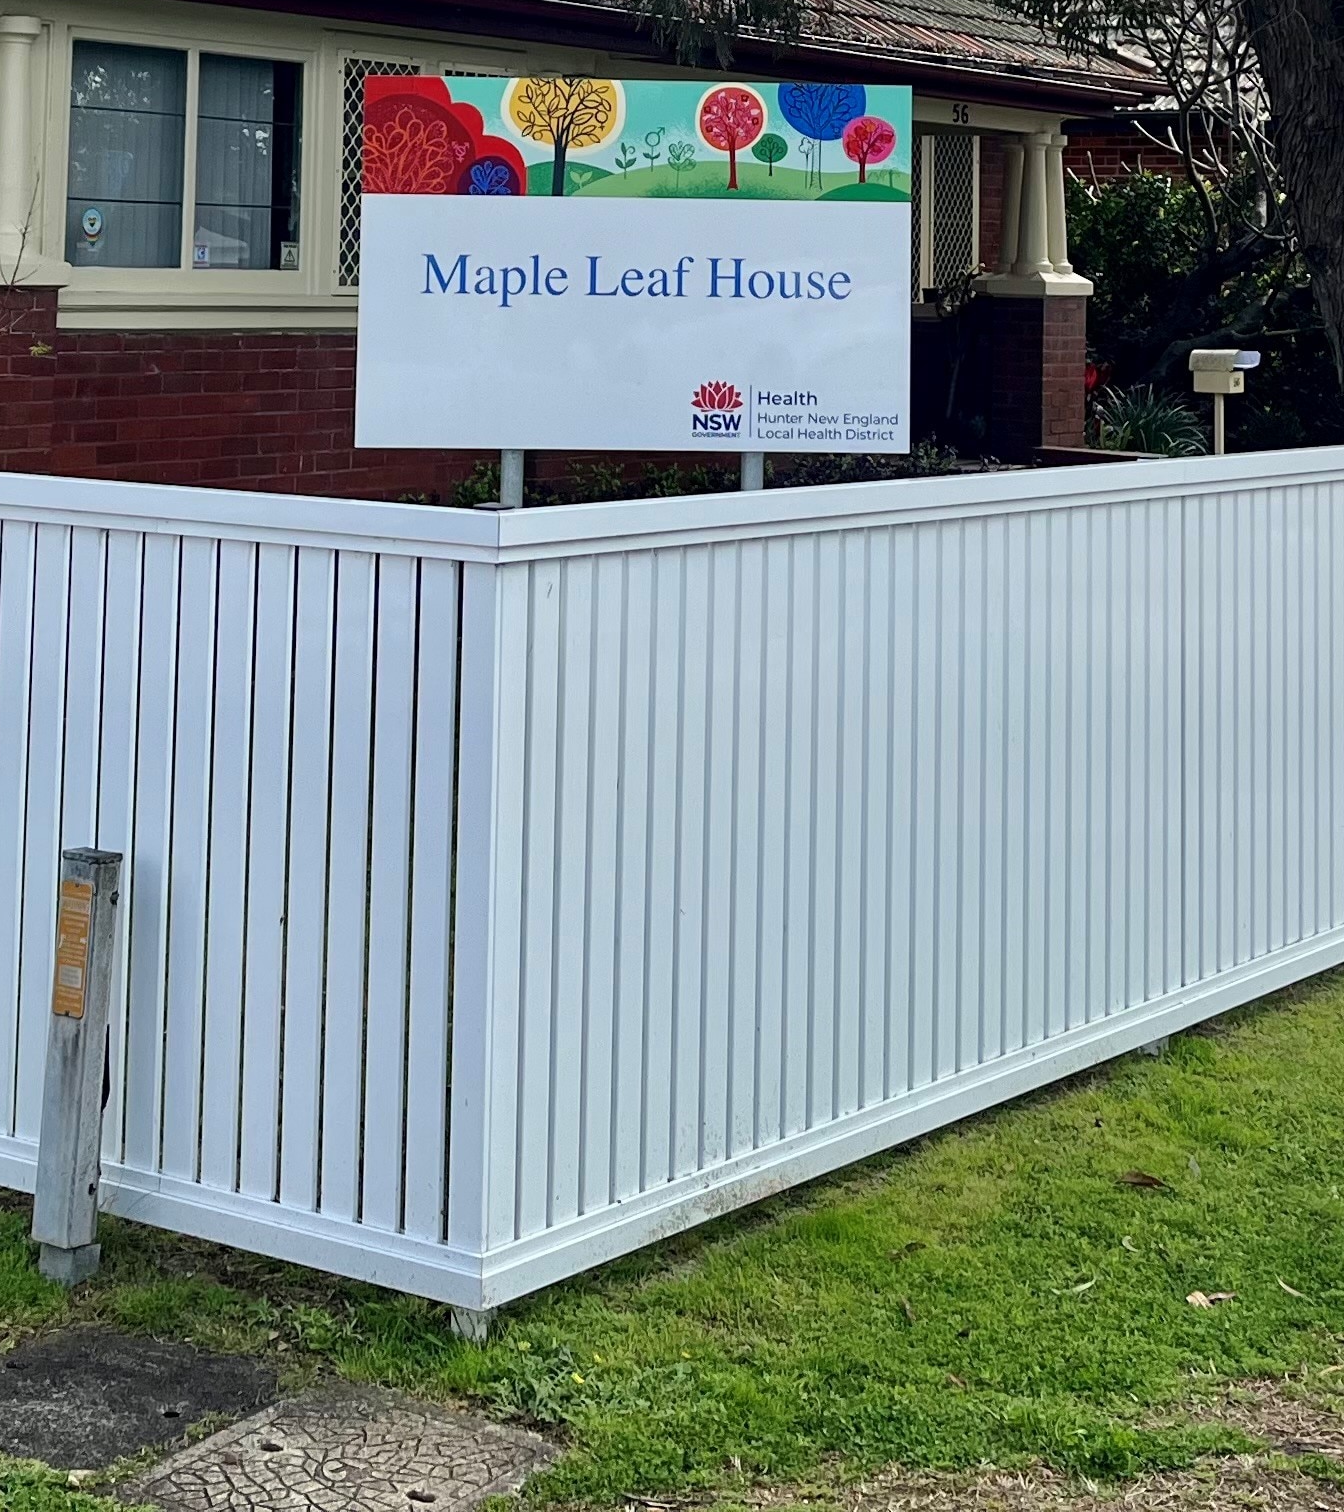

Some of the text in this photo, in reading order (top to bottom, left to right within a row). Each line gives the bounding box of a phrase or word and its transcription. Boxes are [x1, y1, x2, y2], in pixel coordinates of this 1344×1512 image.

[952, 103, 969, 124] 56
[420, 253, 853, 308] Maple Leaf House
[758, 390, 818, 407] Health
[692, 413, 742, 432] NSW
[757, 412, 899, 427] Hunter New England
[757, 428, 895, 441] Local Health District
